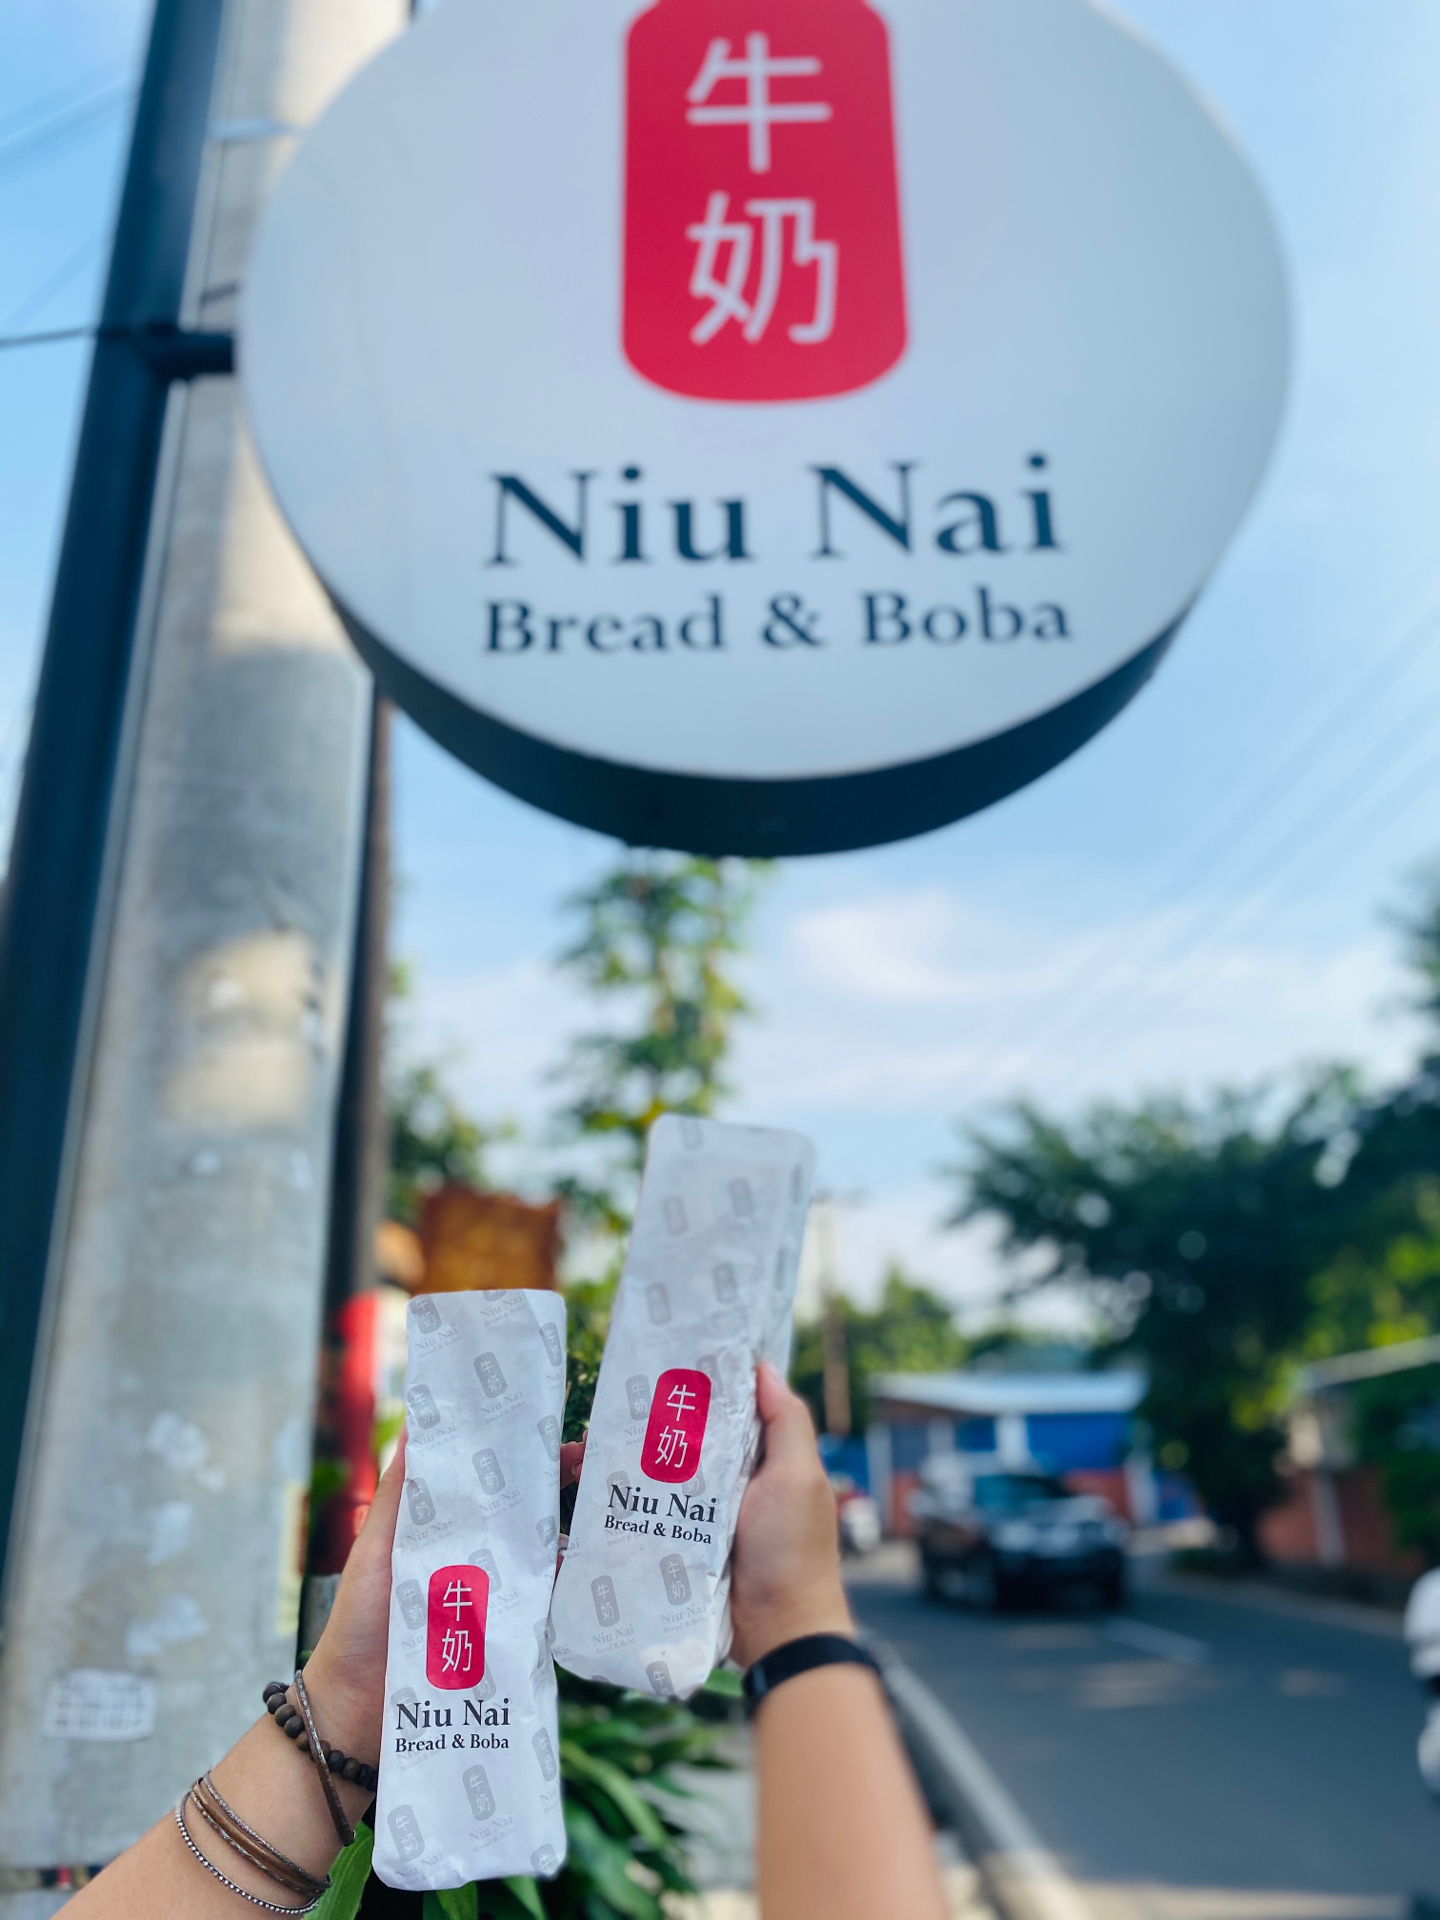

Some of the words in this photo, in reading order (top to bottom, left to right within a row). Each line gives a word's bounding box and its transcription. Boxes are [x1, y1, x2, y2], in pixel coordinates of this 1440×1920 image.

[686, 31, 838, 346] 牛奶
[485, 464, 754, 567] Niu
[810, 452, 1064, 561] Nai
[484, 592, 727, 656] Bread
[761, 592, 826, 651] &
[862, 585, 1071, 647] Boba
[631, 1381, 648, 1414] 牛奶
[655, 1384, 696, 1468] 牛奶
[607, 1484, 658, 1516] Niu
[666, 1492, 716, 1524] Nai
[604, 1514, 649, 1536] Bread
[653, 1522, 666, 1537] &
[671, 1525, 712, 1545] Boba
[667, 1561, 686, 1600] 牛奶
[597, 1584, 615, 1620] 牛奶
[660, 1609, 684, 1626] Niu
[686, 1602, 706, 1618] Nai
[442, 1579, 473, 1673] 牛奶
[592, 1630, 613, 1647] Niu
[615, 1623, 635, 1640] Nai
[395, 1700, 453, 1730] Niu
[462, 1698, 511, 1727] Nai
[395, 1734, 446, 1753] Bread
[451, 1734, 466, 1749] &
[470, 1733, 510, 1749] Boba
